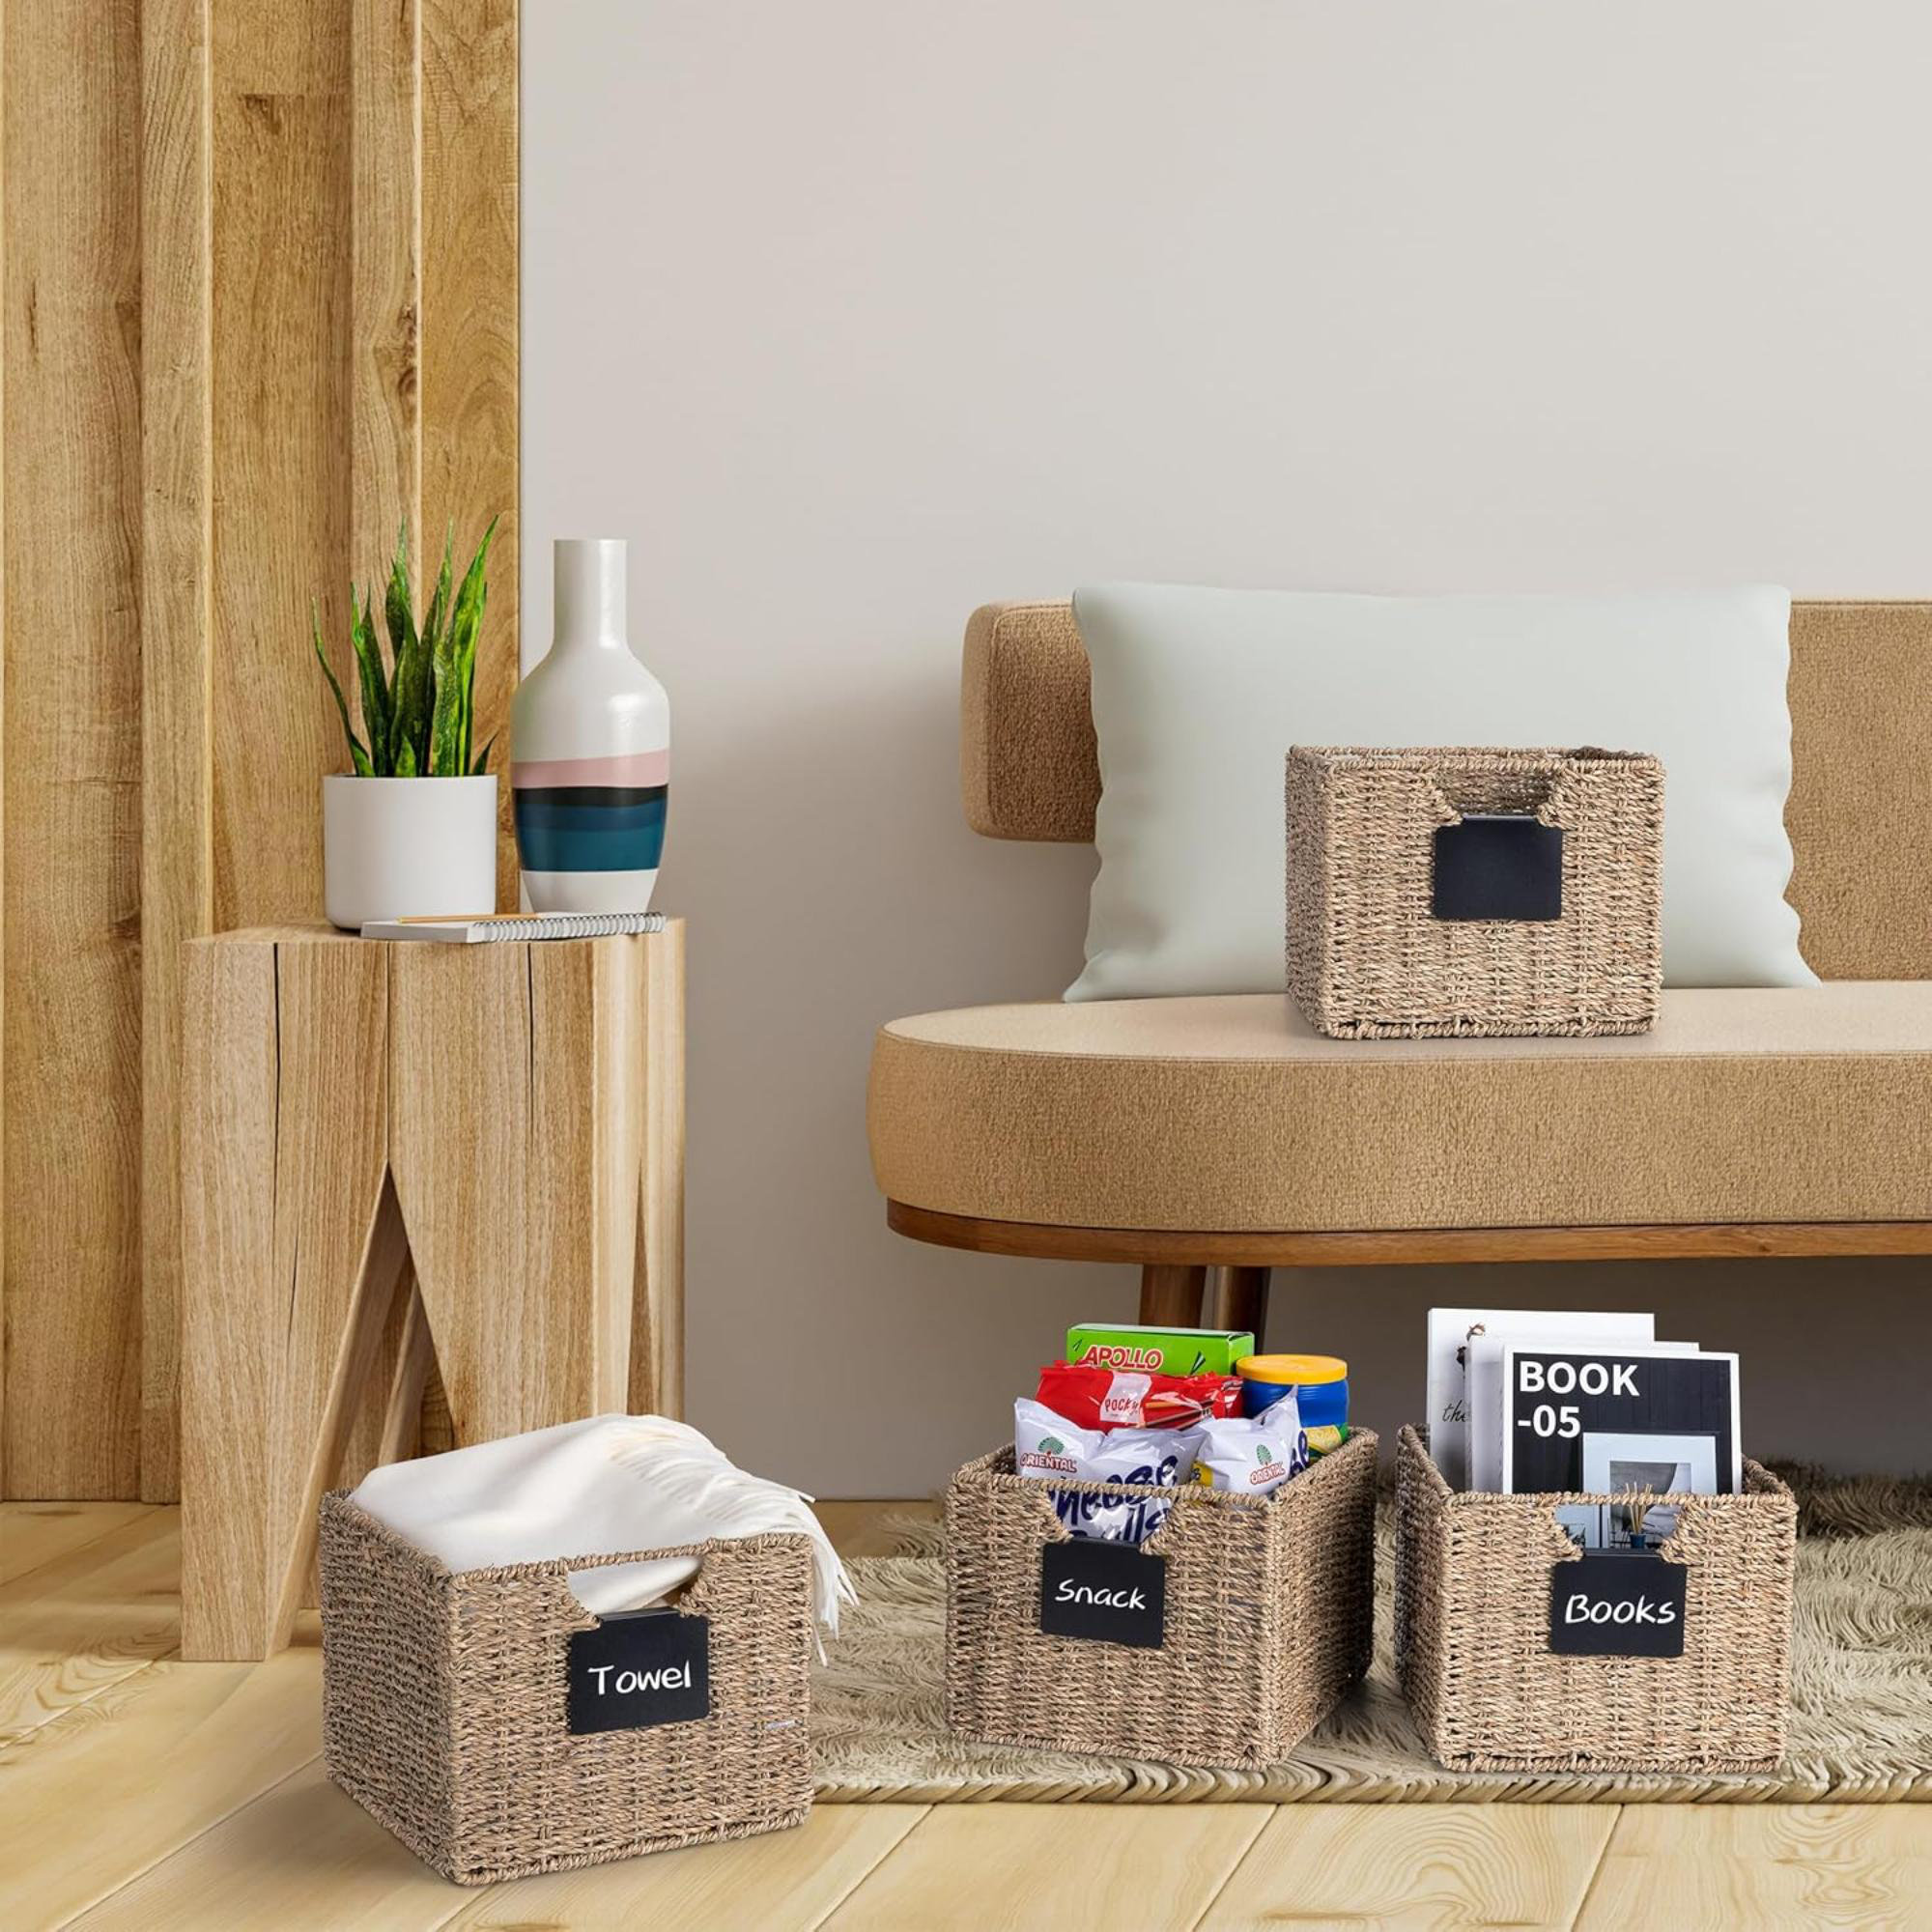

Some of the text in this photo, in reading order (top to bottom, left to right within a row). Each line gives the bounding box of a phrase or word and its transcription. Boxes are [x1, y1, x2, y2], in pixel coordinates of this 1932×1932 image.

[1083, 1344, 1163, 1371] APOLLO
[1520, 1360, 1640, 1397] BOOK
[1517, 1404, 1581, 1438] -05
[1020, 1452, 1078, 1473] ORIENTAL
[1047, 1455, 1179, 1526] heese
[1054, 1577, 1147, 1610] Snack
[1564, 1594, 1677, 1624] Books
[586, 1659, 692, 1695] Towel
